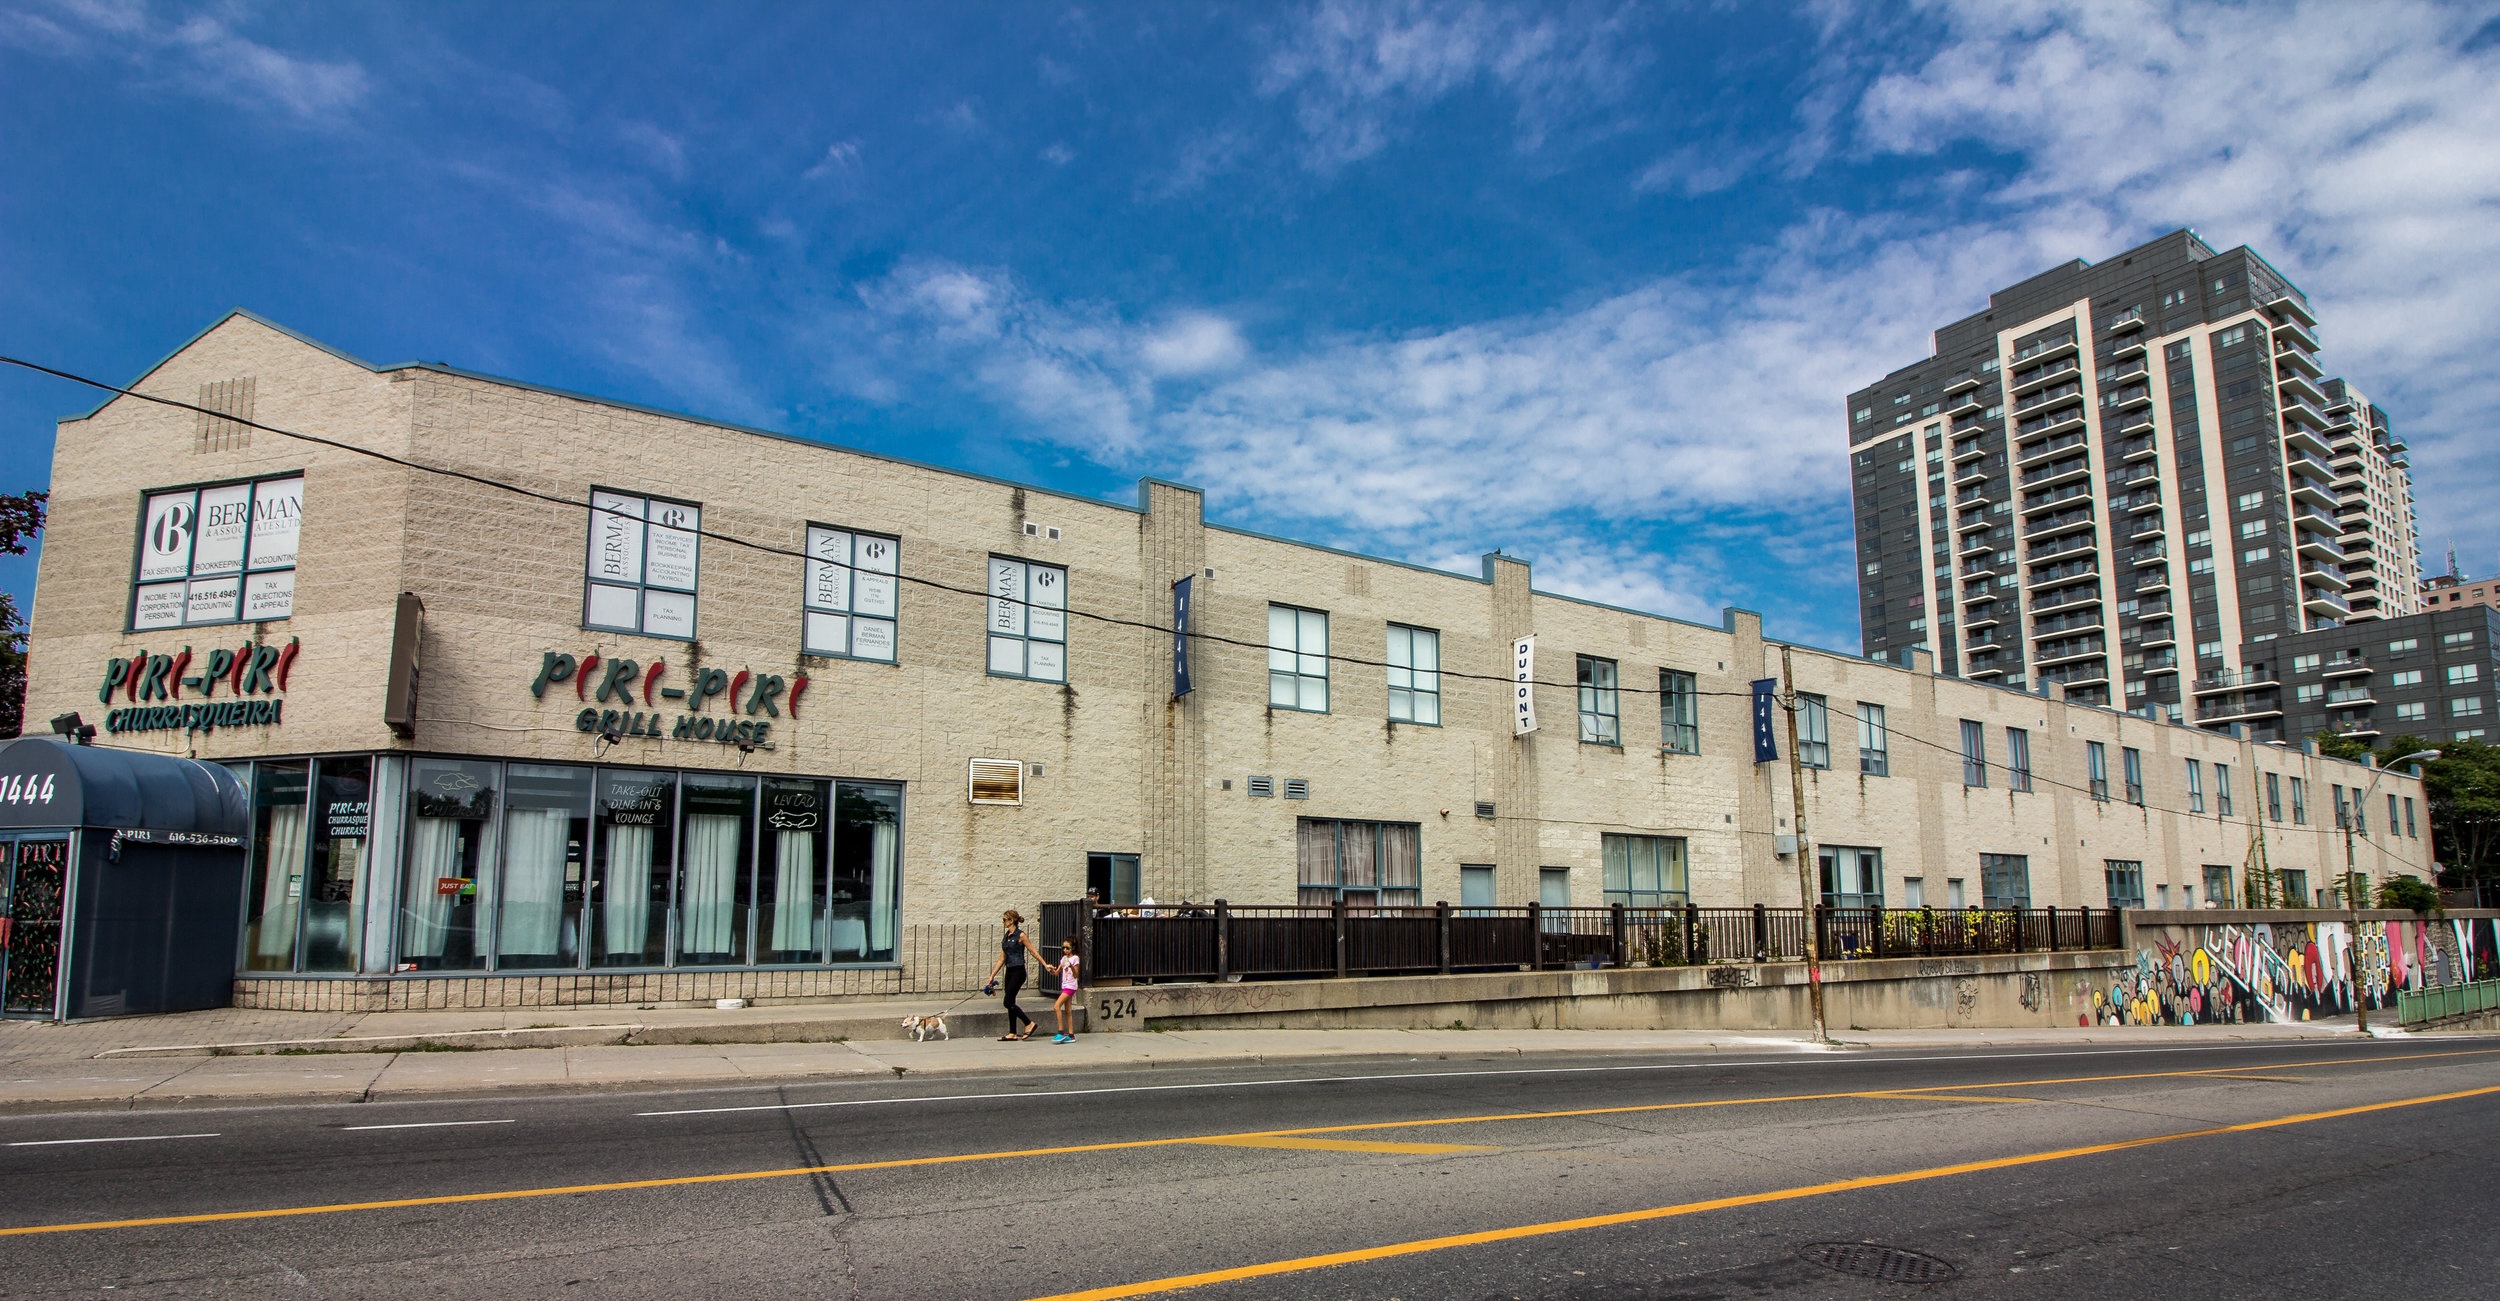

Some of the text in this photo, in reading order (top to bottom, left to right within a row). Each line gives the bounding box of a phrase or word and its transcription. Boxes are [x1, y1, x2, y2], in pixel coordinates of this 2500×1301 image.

[208, 496, 301, 527] BERMAN
[213, 520, 281, 537] ASSOCATES
[604, 499, 624, 575] BERMAN
[143, 565, 188, 576] TAX SERVICES
[195, 559, 243, 571] BOOKKEEPING
[818, 534, 834, 604] BERMAN
[651, 568, 690, 578] ACCOUNTING
[657, 575, 684, 583] PAYROLL
[144, 593, 168, 602] INCOME
[189, 589, 237, 601] 416.516.4949
[251, 590, 293, 601] OBJECTIONS
[998, 565, 1012, 629] BERMAN
[139, 601, 184, 612] CORPORATION
[191, 600, 233, 611] ACCOUNTING
[259, 599, 290, 609] APPEALS
[144, 611, 177, 620] PERSONAL
[653, 613, 683, 622] PLANNING
[861, 632, 885, 640] BERMAN
[863, 626, 884, 634] DANIEL
[856, 637, 891, 646] FERNANDES
[99, 635, 300, 705] PIRI-PIRI
[531, 649, 808, 720] PIRI-PIRI
[1519, 644, 1528, 727] DUPONT
[105, 699, 282, 732] CHURRASQUEIRA
[576, 708, 771, 743] GRILL HOUSE
[0, 774, 55, 805] 1444
[611, 784, 662, 798] TAKE-OUT
[611, 799, 636, 810] DINE
[615, 810, 655, 824] LOUNGE
[1101, 998, 1137, 1020] 524
